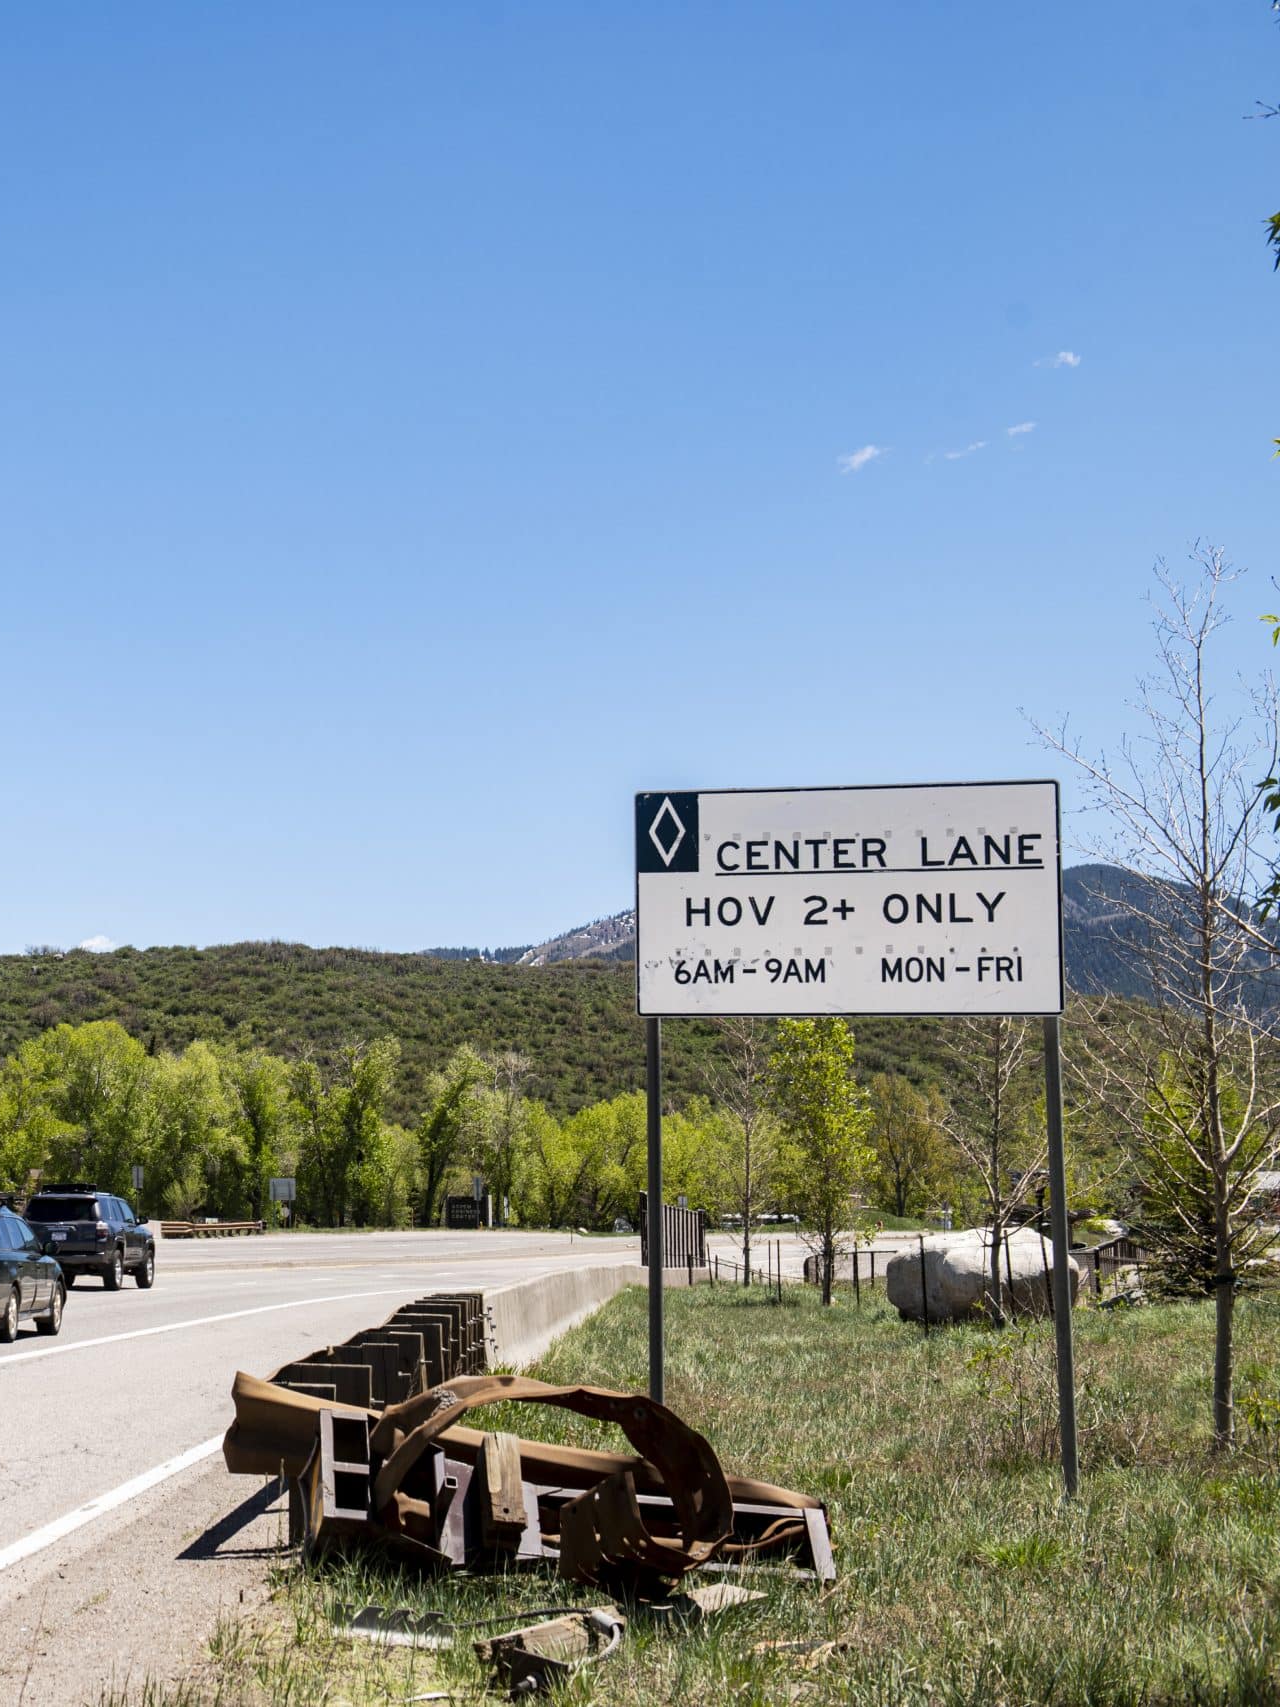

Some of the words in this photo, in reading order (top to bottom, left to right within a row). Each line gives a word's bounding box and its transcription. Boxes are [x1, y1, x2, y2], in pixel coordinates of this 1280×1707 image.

[716, 838, 888, 871] CENTER
[920, 834, 1043, 867] LANE
[686, 895, 775, 927] HOV
[803, 896, 855, 926] 2+
[882, 892, 1007, 925] ONLY
